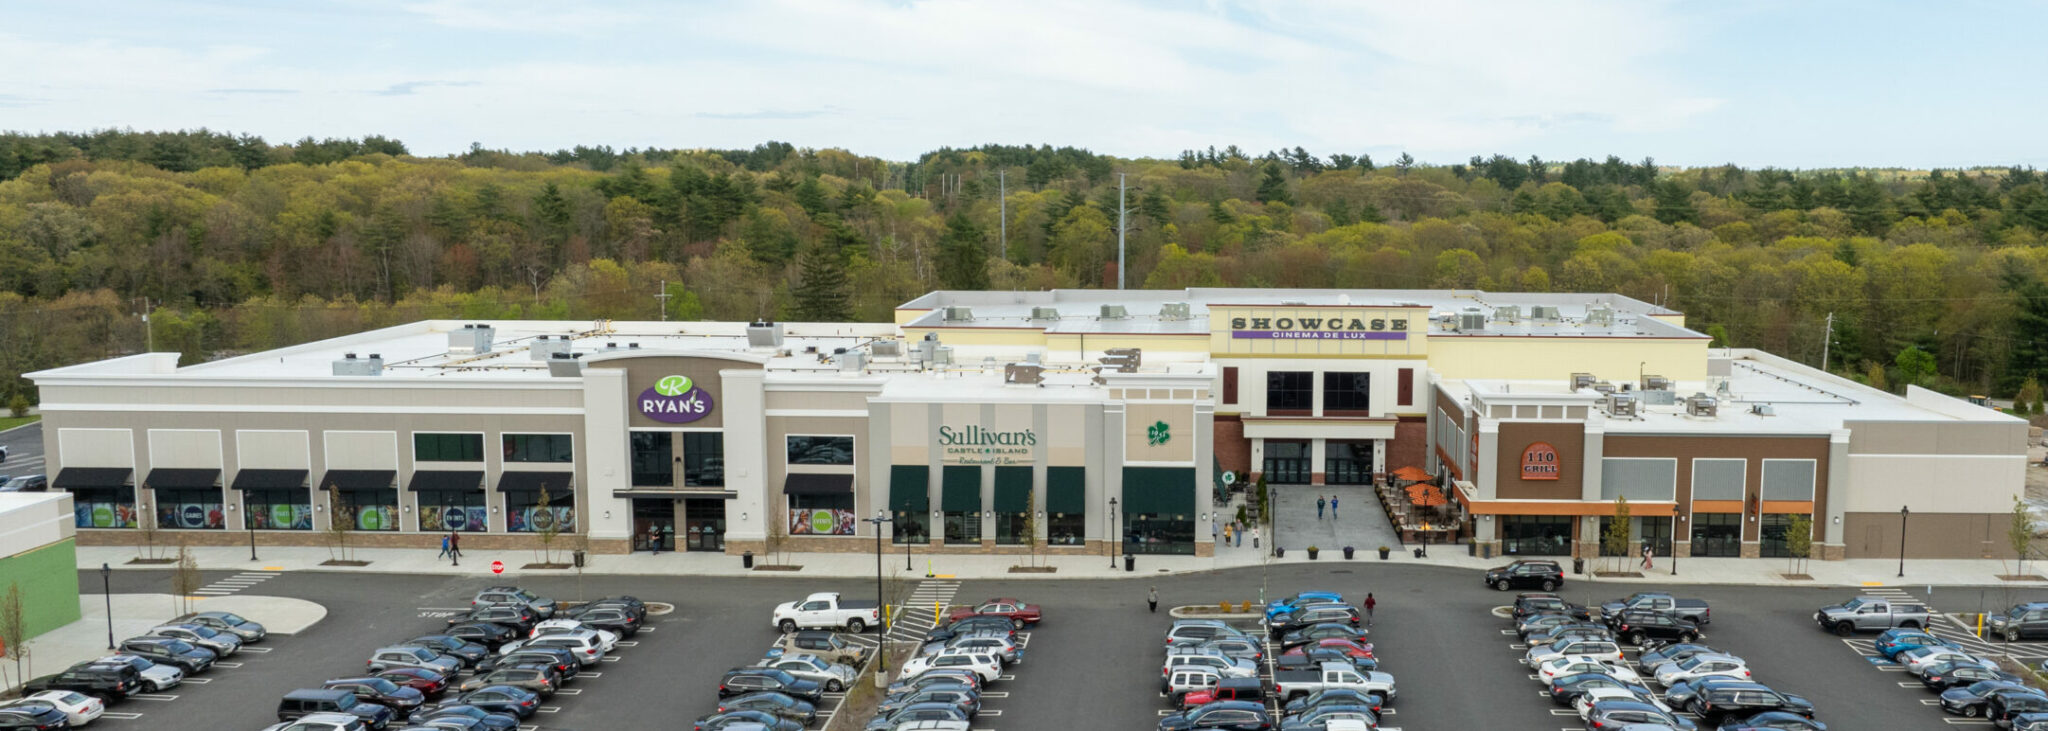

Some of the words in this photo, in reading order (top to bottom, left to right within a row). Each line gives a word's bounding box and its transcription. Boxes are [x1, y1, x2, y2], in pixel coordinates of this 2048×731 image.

[1231, 317, 1408, 330] SHOWCASE
[1343, 332, 1366, 340] LUX
[659, 375, 687, 396] R
[643, 398, 706, 413] RYAN'S
[938, 424, 1037, 446] Sullivan's
[992, 447, 1028, 455] ISLAND
[1527, 451, 1554, 462] 110
[1524, 465, 1557, 473] GRILL
